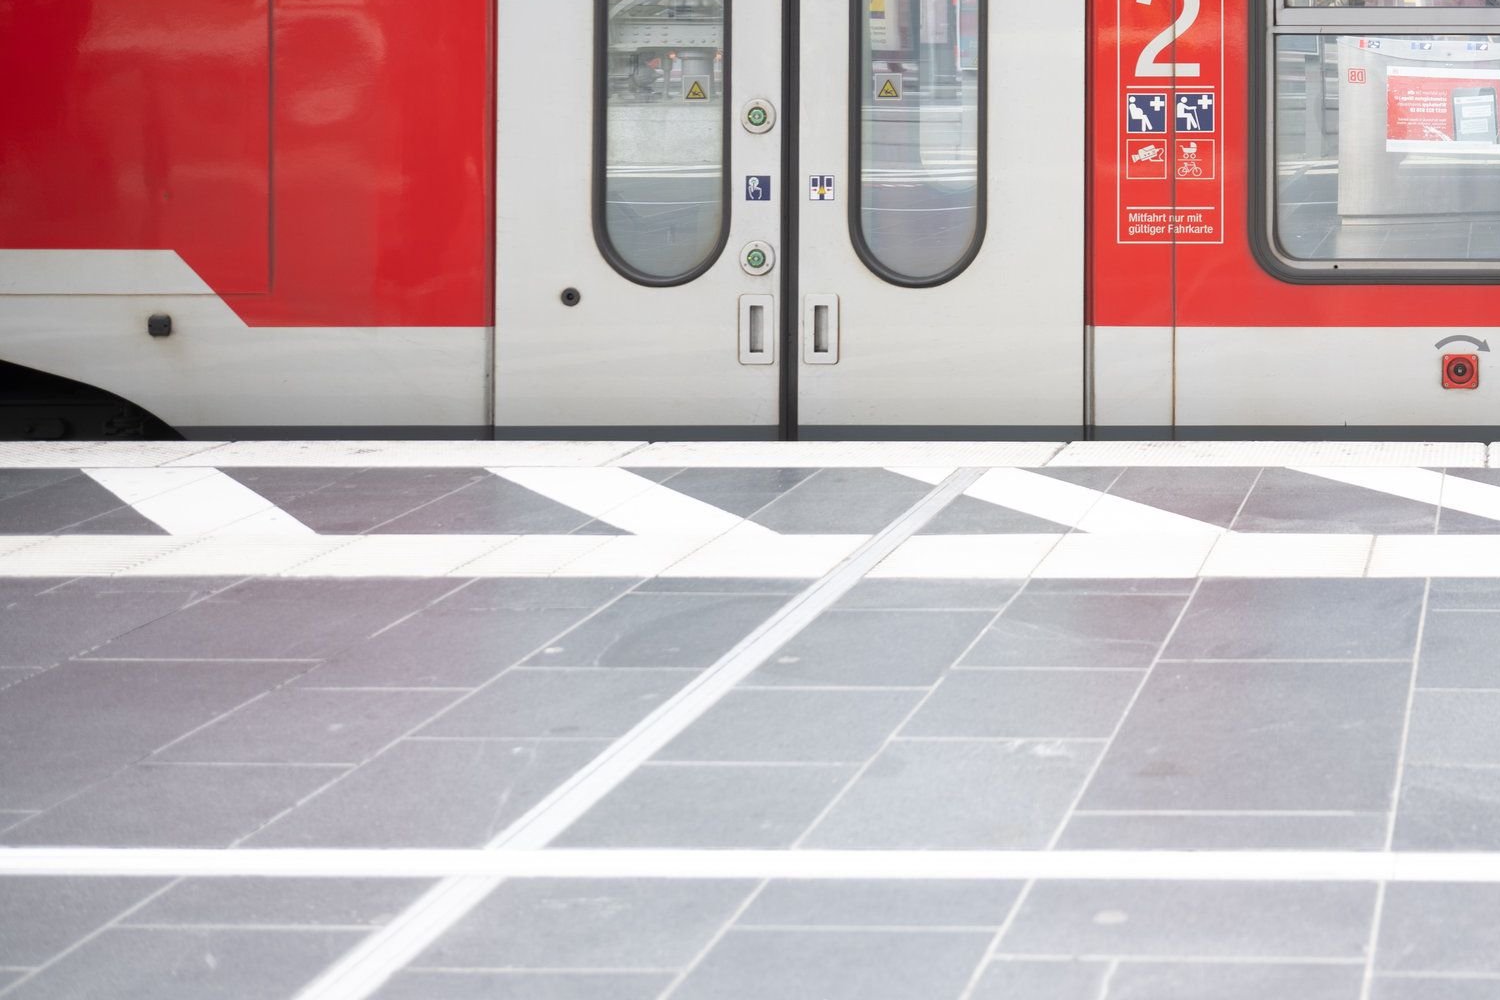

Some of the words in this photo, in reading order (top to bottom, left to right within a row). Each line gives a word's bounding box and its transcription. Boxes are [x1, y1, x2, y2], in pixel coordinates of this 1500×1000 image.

[1128, 213, 1167, 223] Mitfahrt
[1168, 214, 1185, 223] nur
[1187, 213, 1203, 223] mit
[1128, 224, 1166, 236] gültiger
[1167, 224, 1214, 234] Fahrkarte
